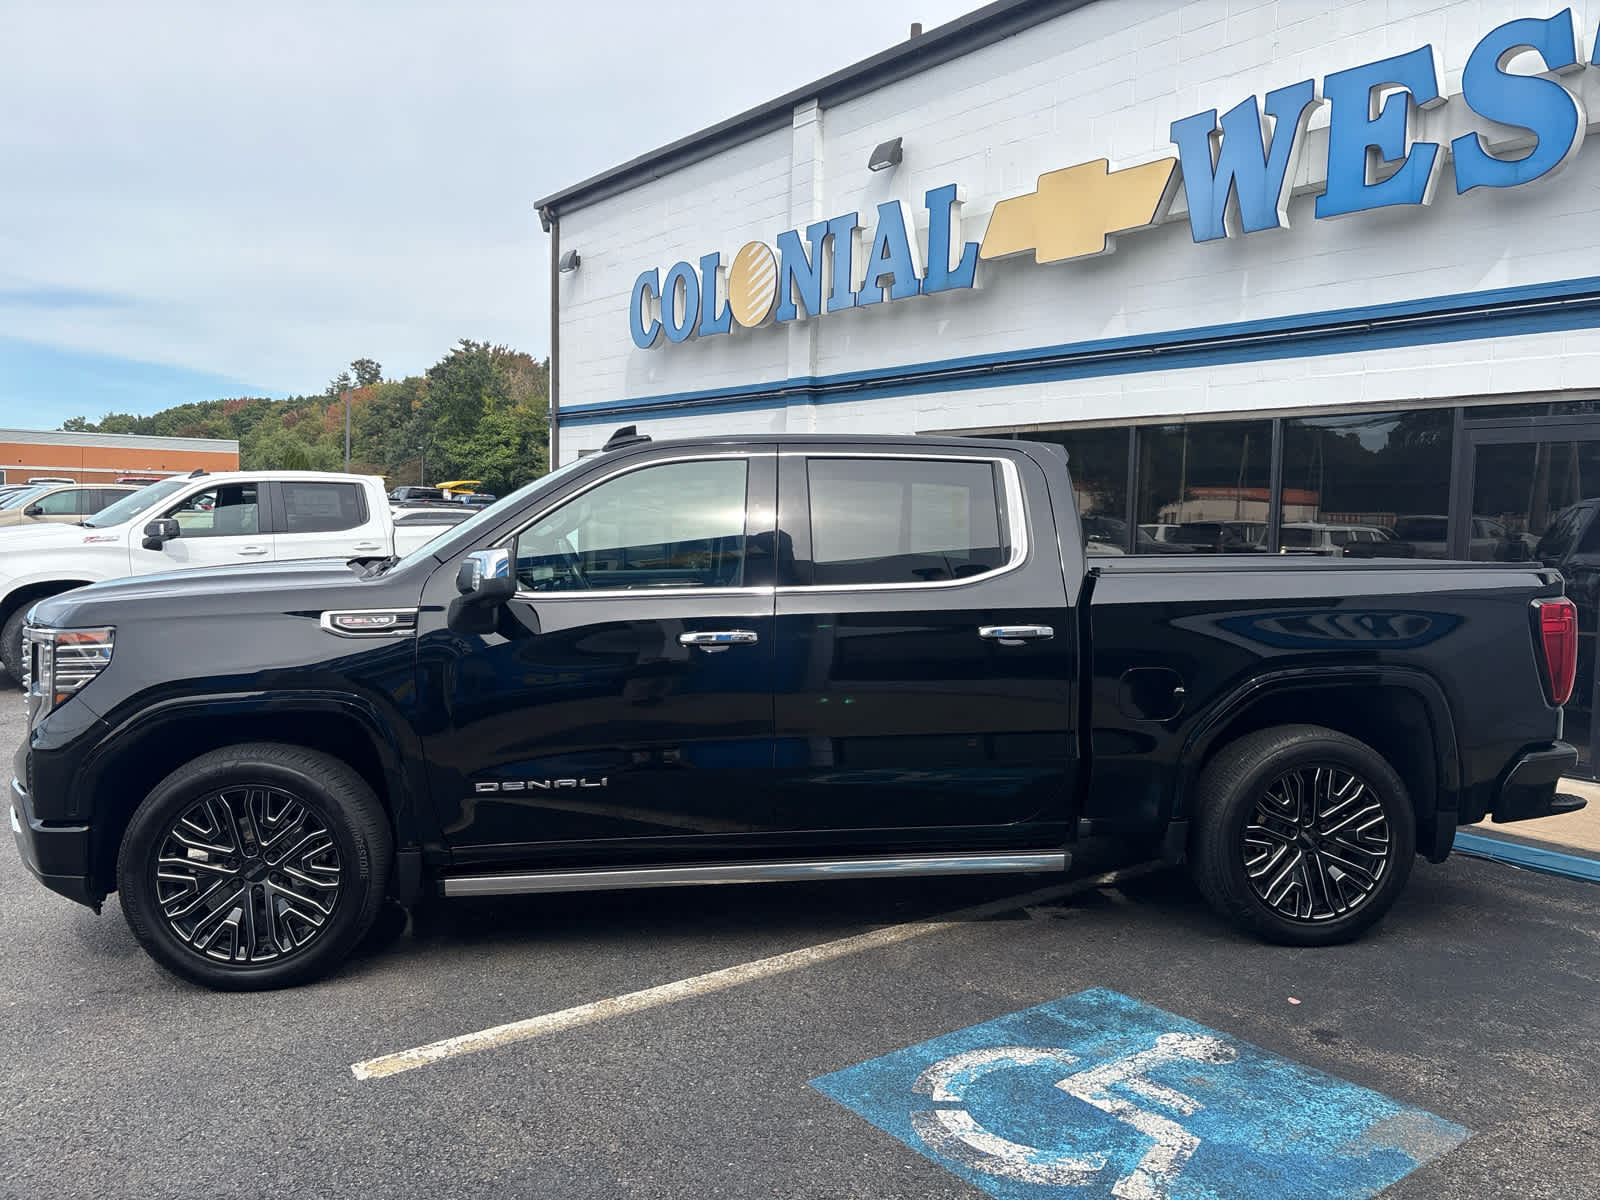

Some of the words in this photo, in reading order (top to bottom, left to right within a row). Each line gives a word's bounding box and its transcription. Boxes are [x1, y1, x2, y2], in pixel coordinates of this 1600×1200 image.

[630, 183, 979, 348] COLONIAL
[1170, 7, 1600, 243] WES
[475, 777, 608, 793] DENALI
